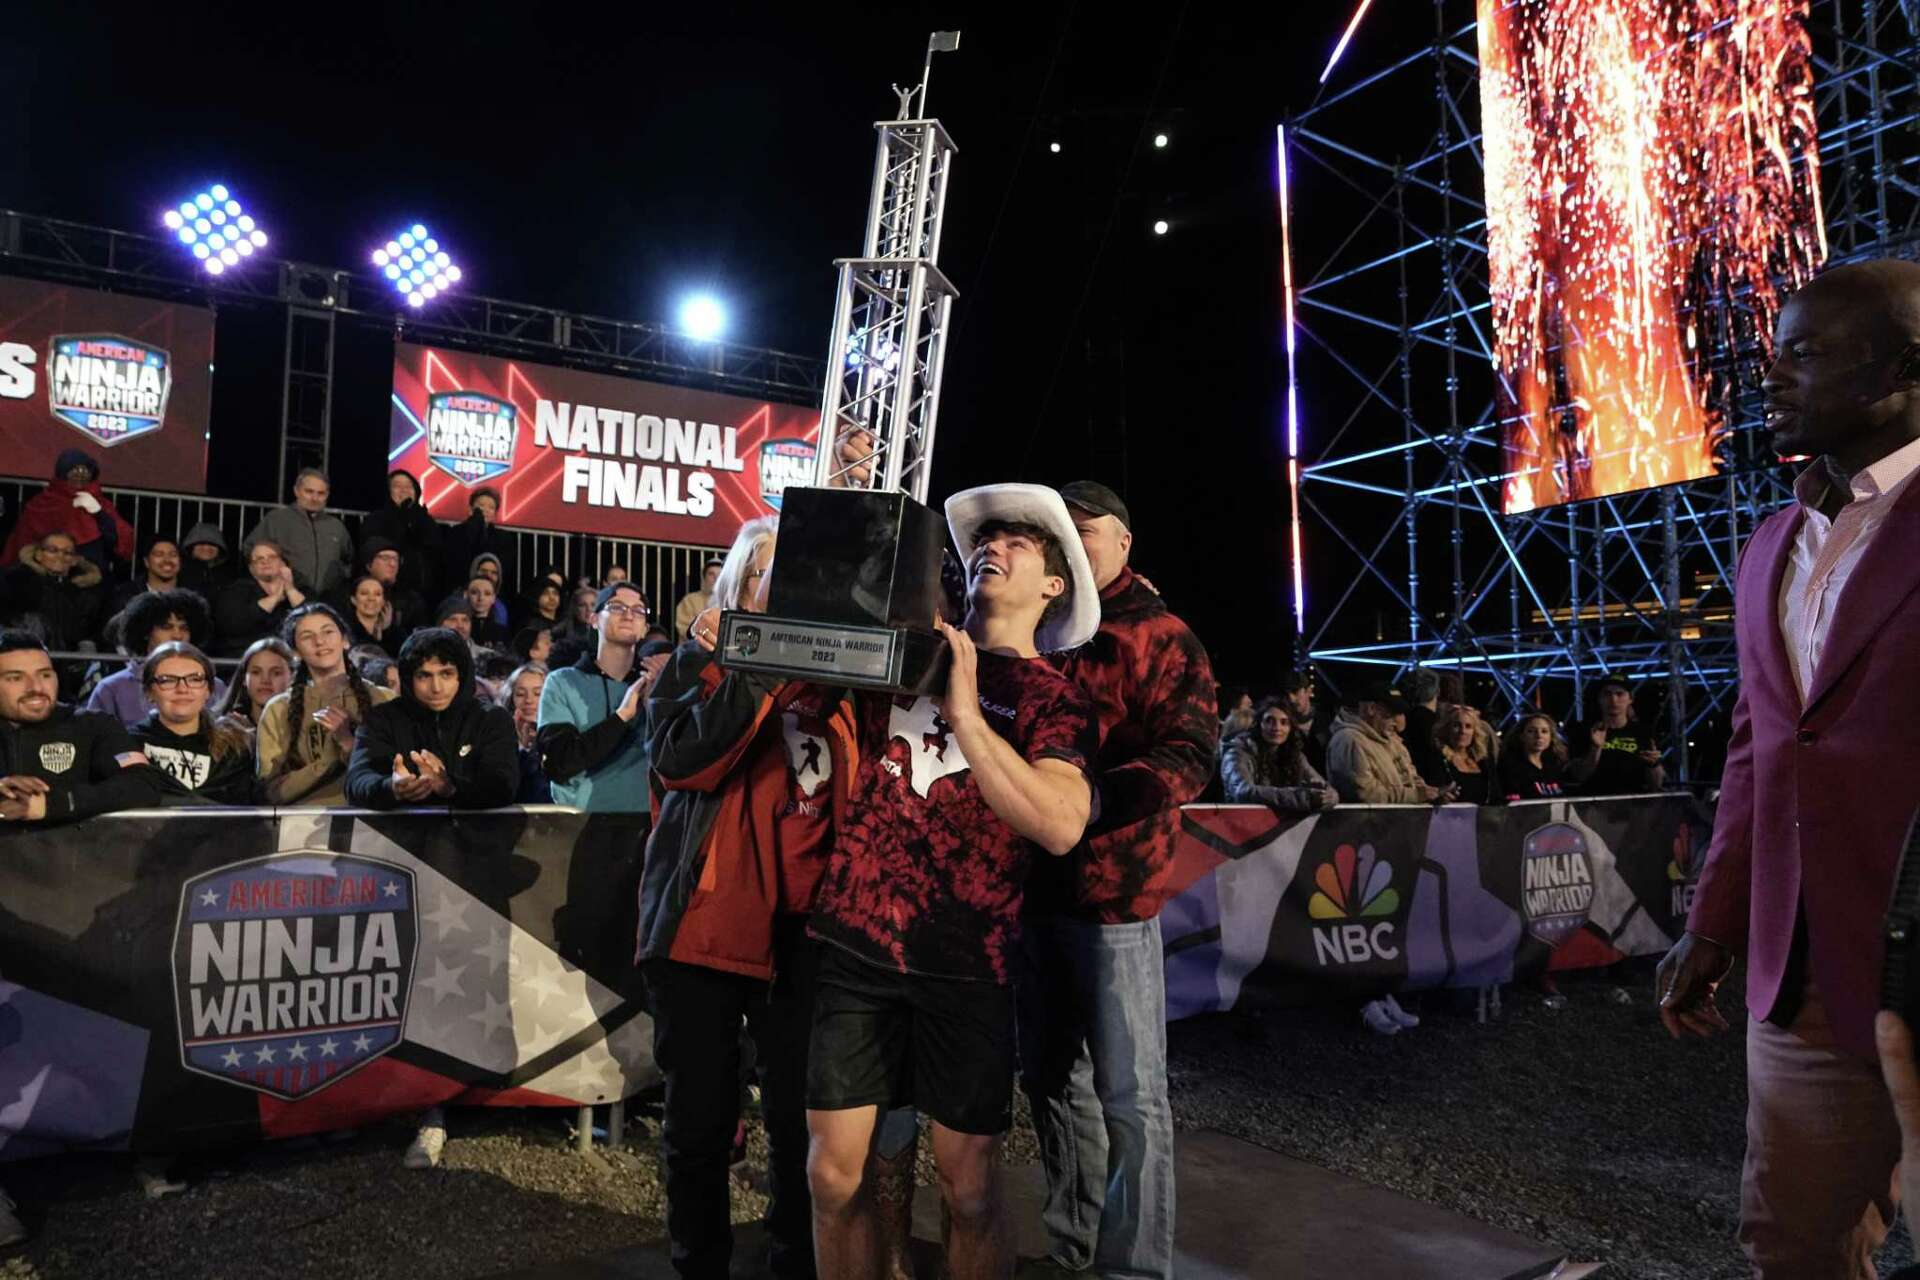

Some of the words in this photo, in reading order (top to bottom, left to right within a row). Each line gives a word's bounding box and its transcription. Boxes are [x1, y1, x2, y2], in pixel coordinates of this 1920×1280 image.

[77, 341, 146, 361] AMERICAN
[55, 354, 161, 394] NINJA
[55, 381, 160, 414] WARRIOR
[87, 414, 128, 431] 2023
[430, 409, 511, 441] NINJA
[534, 399, 744, 471] NATIONAL
[430, 430, 510, 460] WARRIOR
[563, 455, 715, 517] FINALS
[770, 632, 813, 646] AMERICAN
[815, 636, 842, 648] NINJA
[845, 641, 885, 653] WARRIOR
[811, 650, 835, 662] 2023
[1526, 853, 1591, 889] NINJA
[226, 876, 378, 912] AMERICAN
[190, 912, 401, 984] NINJA
[1312, 921, 1399, 965] NBC
[190, 972, 400, 1037] WARRIOR
